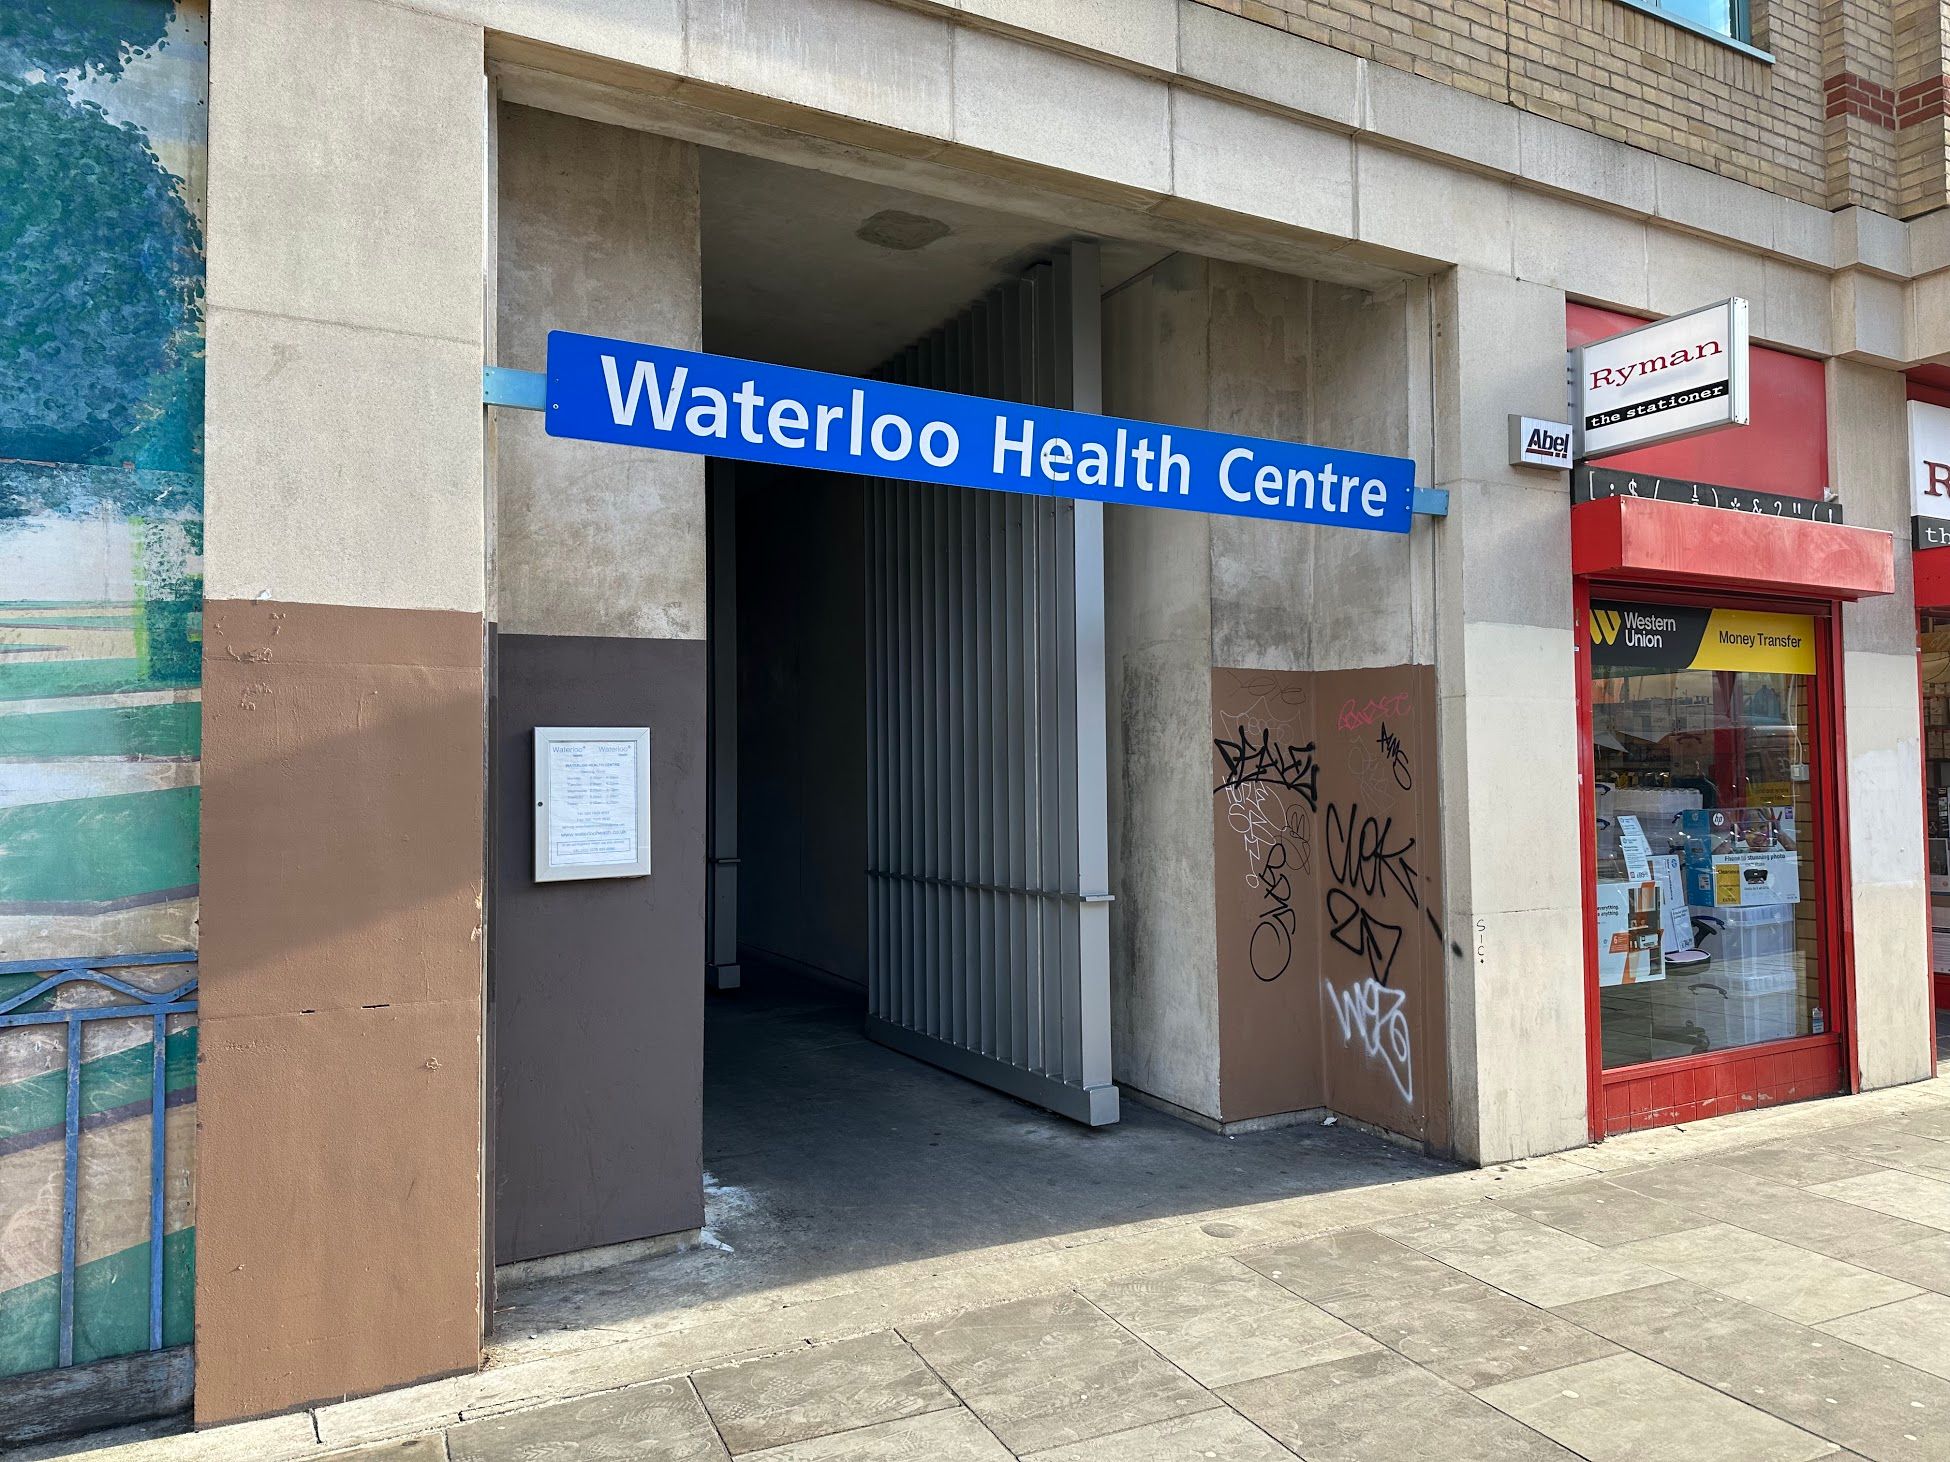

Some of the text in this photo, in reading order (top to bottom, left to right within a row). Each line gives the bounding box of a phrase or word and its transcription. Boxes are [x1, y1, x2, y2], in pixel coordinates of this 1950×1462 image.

[1589, 340, 1722, 390] Ryman
[1591, 385, 1723, 427] the stationer
[600, 355, 1388, 517] Waterloo Health Centre
[1624, 611, 1677, 632] Western
[1625, 630, 1663, 648] Union
[1719, 630, 1802, 648] Money Transfer
